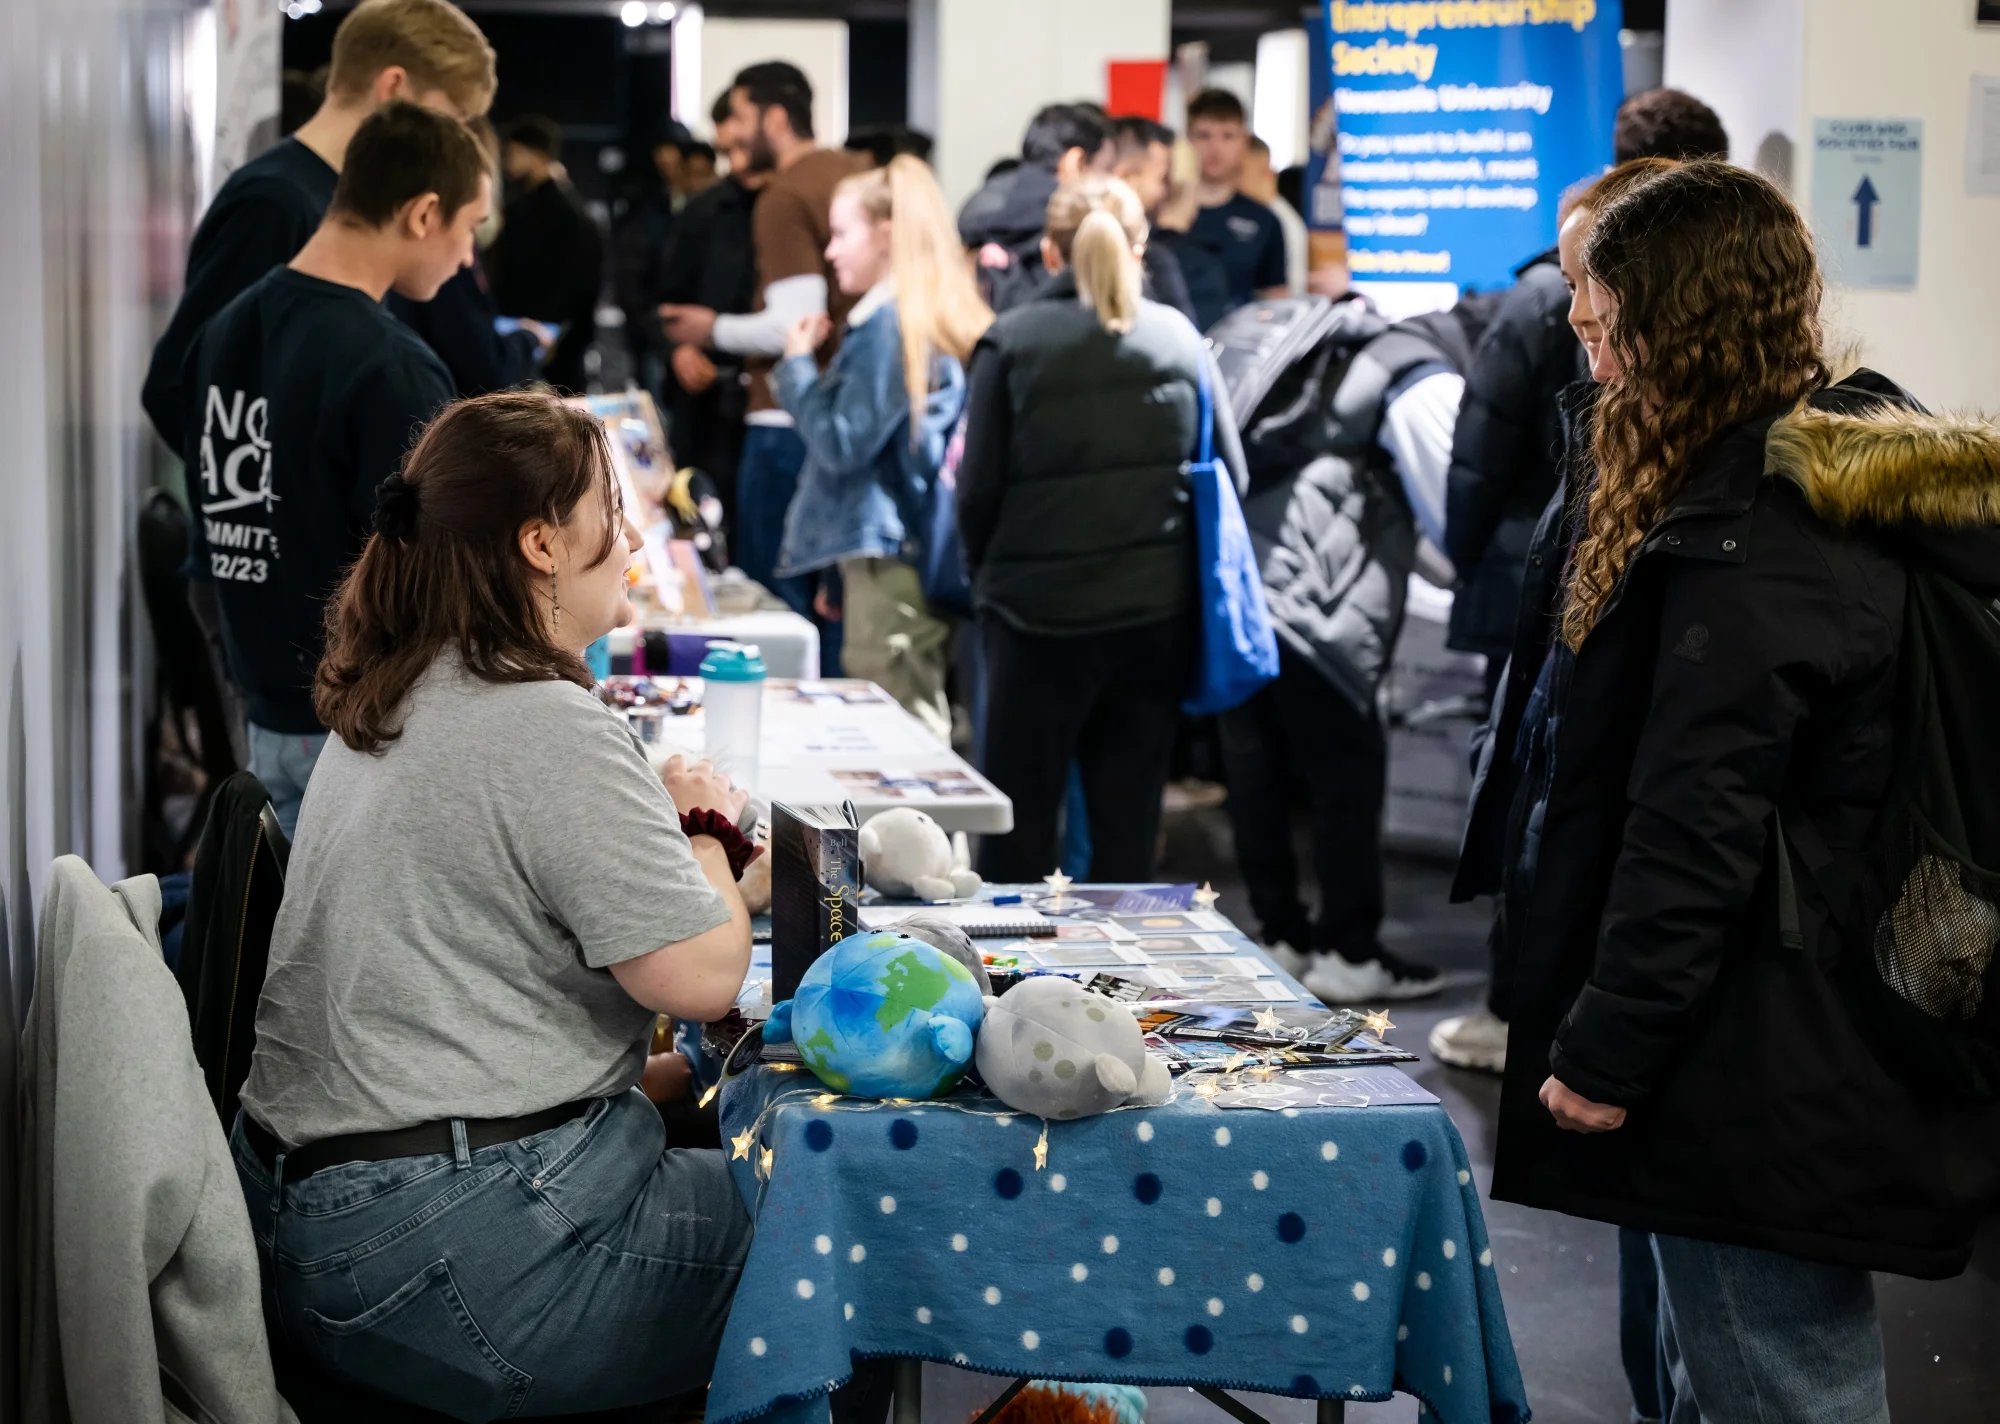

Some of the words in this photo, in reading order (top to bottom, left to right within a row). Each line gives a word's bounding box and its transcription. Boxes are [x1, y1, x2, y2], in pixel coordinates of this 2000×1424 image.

[1331, 0, 1596, 38] Entrepreneurship
[1332, 38, 1438, 81] Society
[1334, 84, 1438, 114] Newcastle
[1438, 81, 1553, 115] University
[830, 857, 842, 879] The
[823, 884, 849, 943] Space
